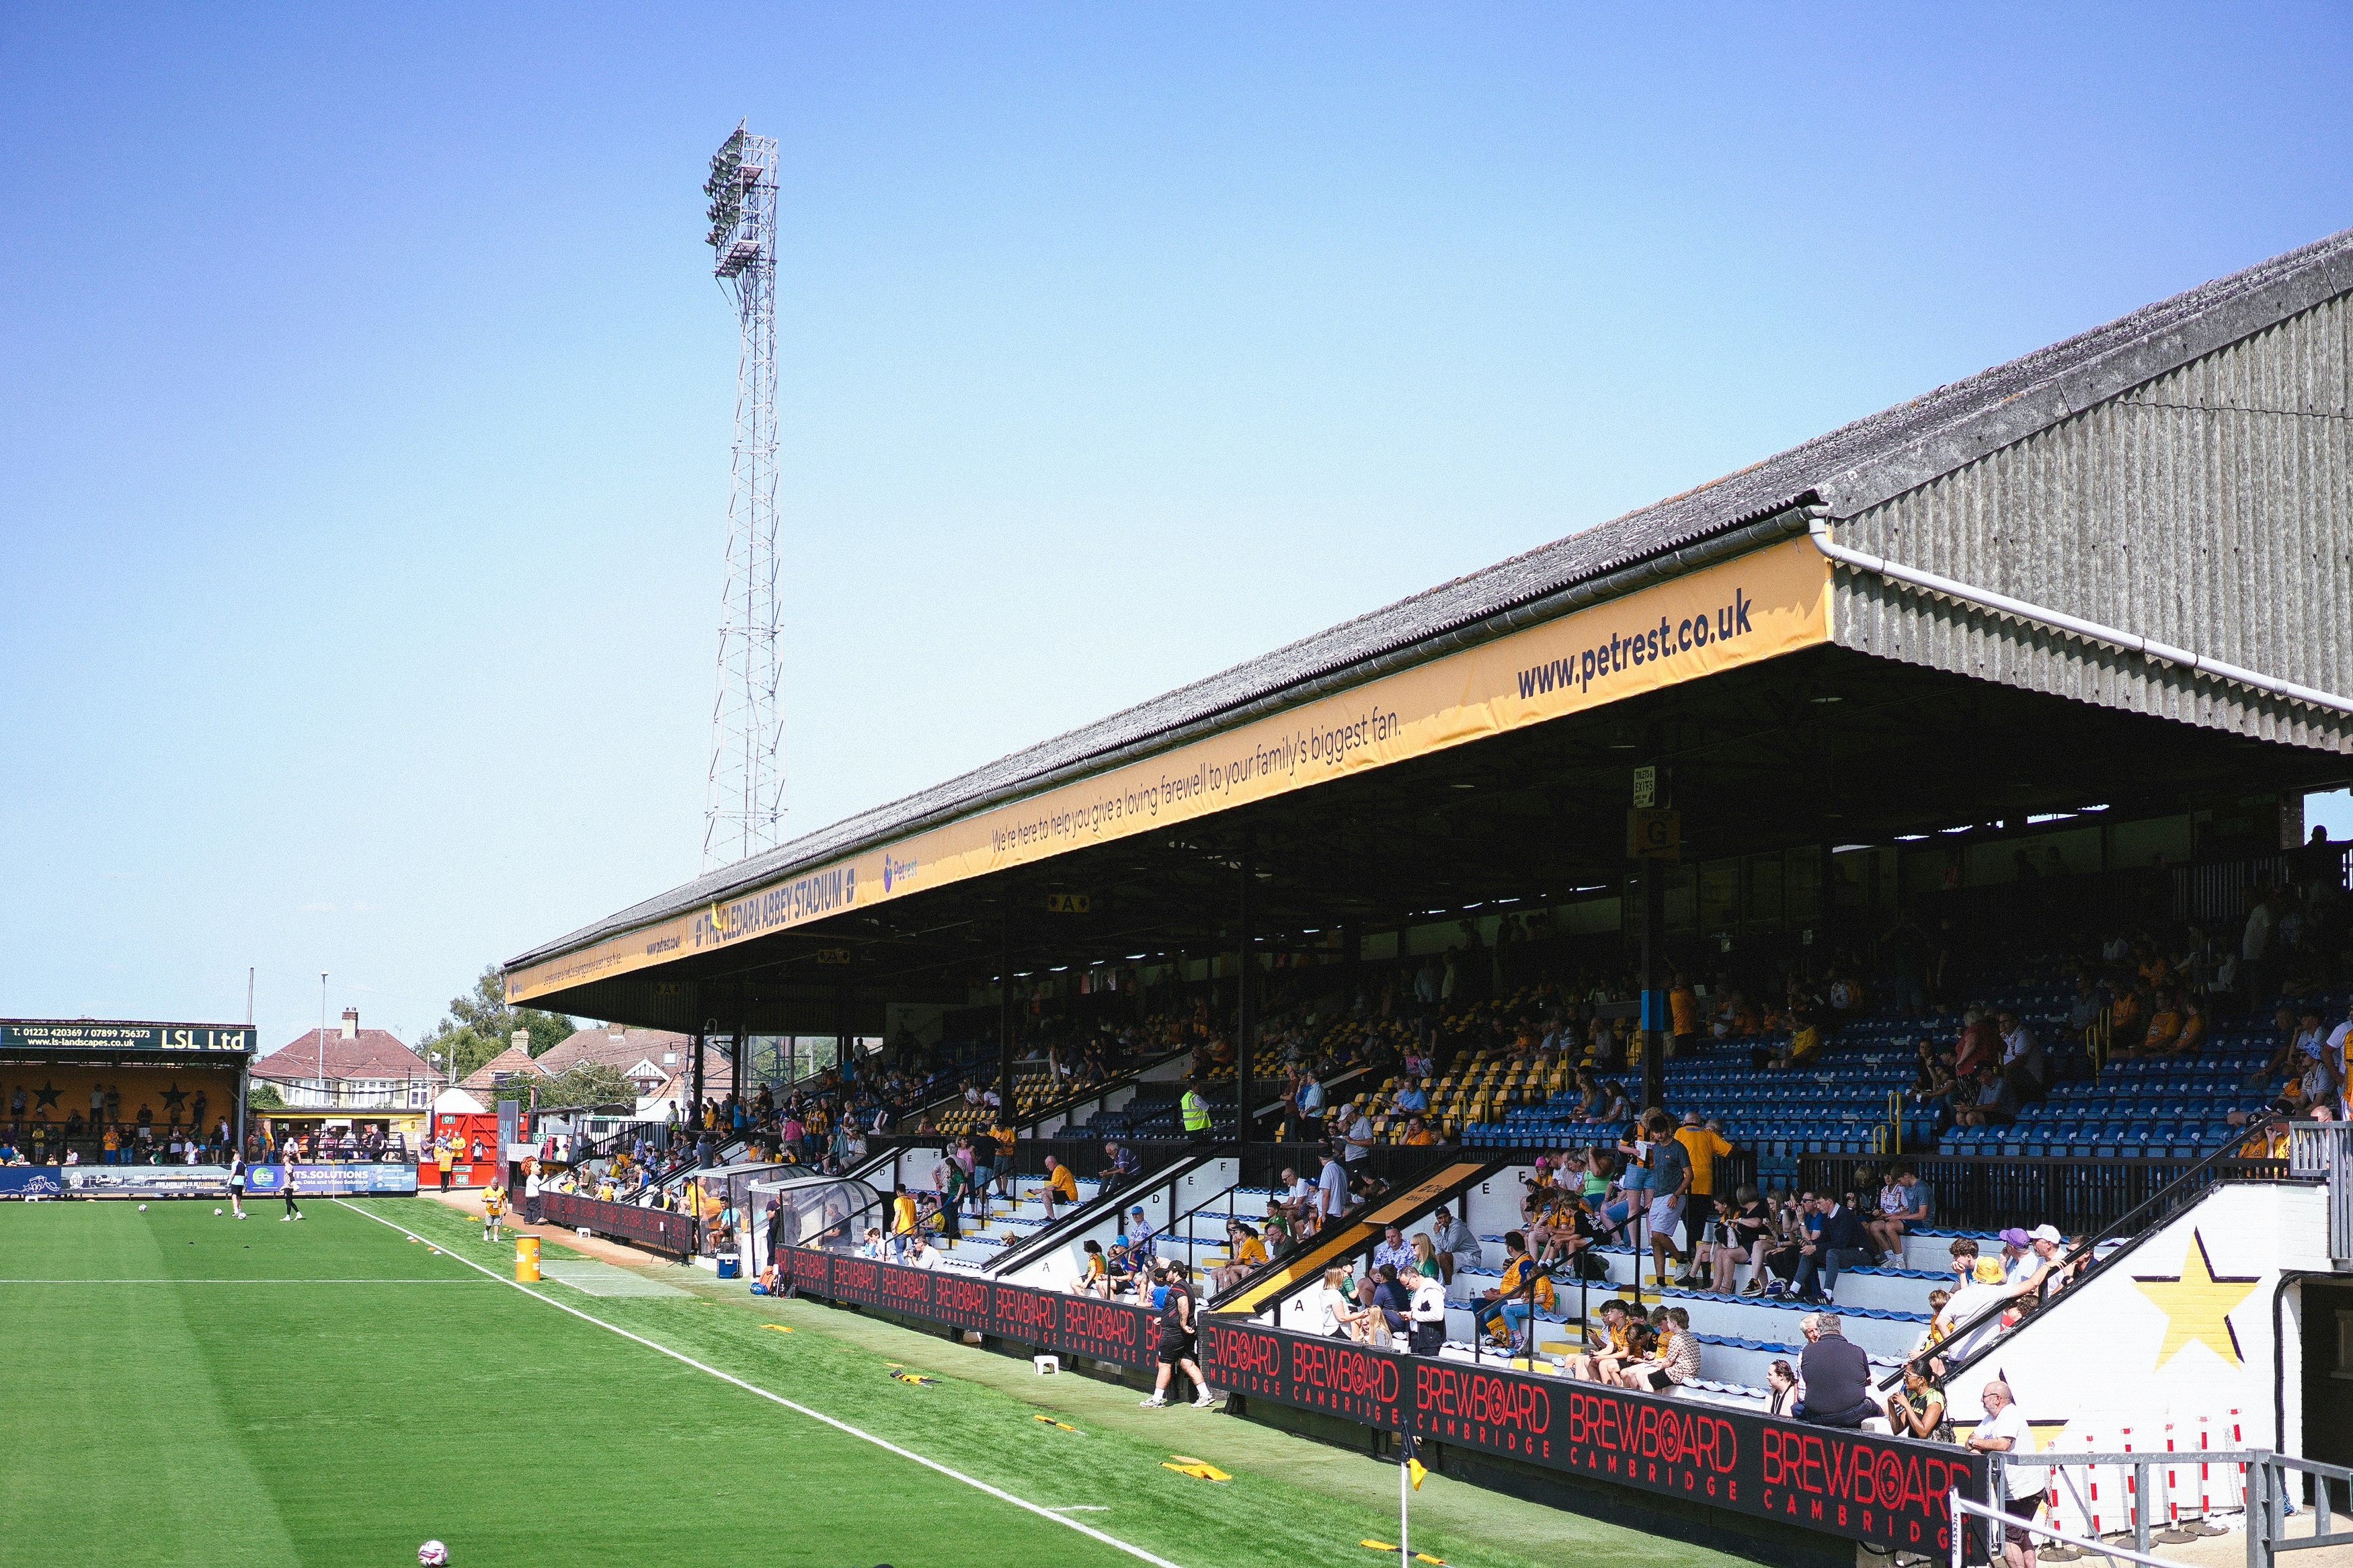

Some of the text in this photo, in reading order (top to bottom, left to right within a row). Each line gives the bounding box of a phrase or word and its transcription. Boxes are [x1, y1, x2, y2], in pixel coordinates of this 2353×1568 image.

[1518, 588, 1753, 699] www.petrest.co.uk
[991, 706, 1402, 853] We're here to help you give a loving farewell to your family's biggest fan.
[1635, 780, 1653, 793] EXITS
[1648, 819, 1667, 845] G
[894, 856, 917, 882] Petrest
[721, 898, 760, 942] CLEDARA
[762, 885, 793, 933] ABBEY
[795, 869, 842, 919] STADIUM
[1062, 896, 1075, 911] A
[12, 1028, 21, 1036] T.
[23, 1028, 48, 1036] 01223
[50, 1028, 82, 1037] 420369
[91, 1029, 118, 1038] 07899
[120, 1030, 151, 1038] 756373
[28, 1037, 134, 1047] www.ls-landscapes.co.uk
[161, 1030, 245, 1050] LSL Ltd
[534, 1134, 546, 1142] 02
[1220, 1162, 1226, 1171] F
[1518, 1171, 1526, 1183] F
[1188, 1176, 1193, 1185] E
[1482, 1183, 1490, 1194] E
[1152, 1194, 1160, 1204] D
[1123, 1216, 1129, 1225] C
[834, 1259, 878, 1291] BREWBOARD
[1042, 1262, 1050, 1272] A
[834, 1286, 878, 1304] CAMBRIDGE
[882, 1267, 930, 1303] BREWBOARD
[936, 1277, 990, 1315] BREWBOARD
[881, 1295, 930, 1316] CAMBRIDGE
[996, 1287, 1058, 1329] BREWBOARD
[1294, 1299, 1304, 1311] A
[935, 1309, 989, 1329] CAMBRIDGE
[1065, 1299, 1136, 1346] BREWBOARD
[995, 1321, 1058, 1345] CAMBRIDGE
[1065, 1335, 1136, 1363] CAMBRIDGE
[1293, 1342, 1399, 1403] BREWBOARD
[1293, 1385, 1399, 1425] CAMBRIDGE
[1417, 1364, 1550, 1434] BREWBOARD
[1417, 1413, 1550, 1458] CAMBRIDGE
[1570, 1393, 1737, 1474] BREWBOARD
[1570, 1446, 1737, 1501] CAMBRIDGE
